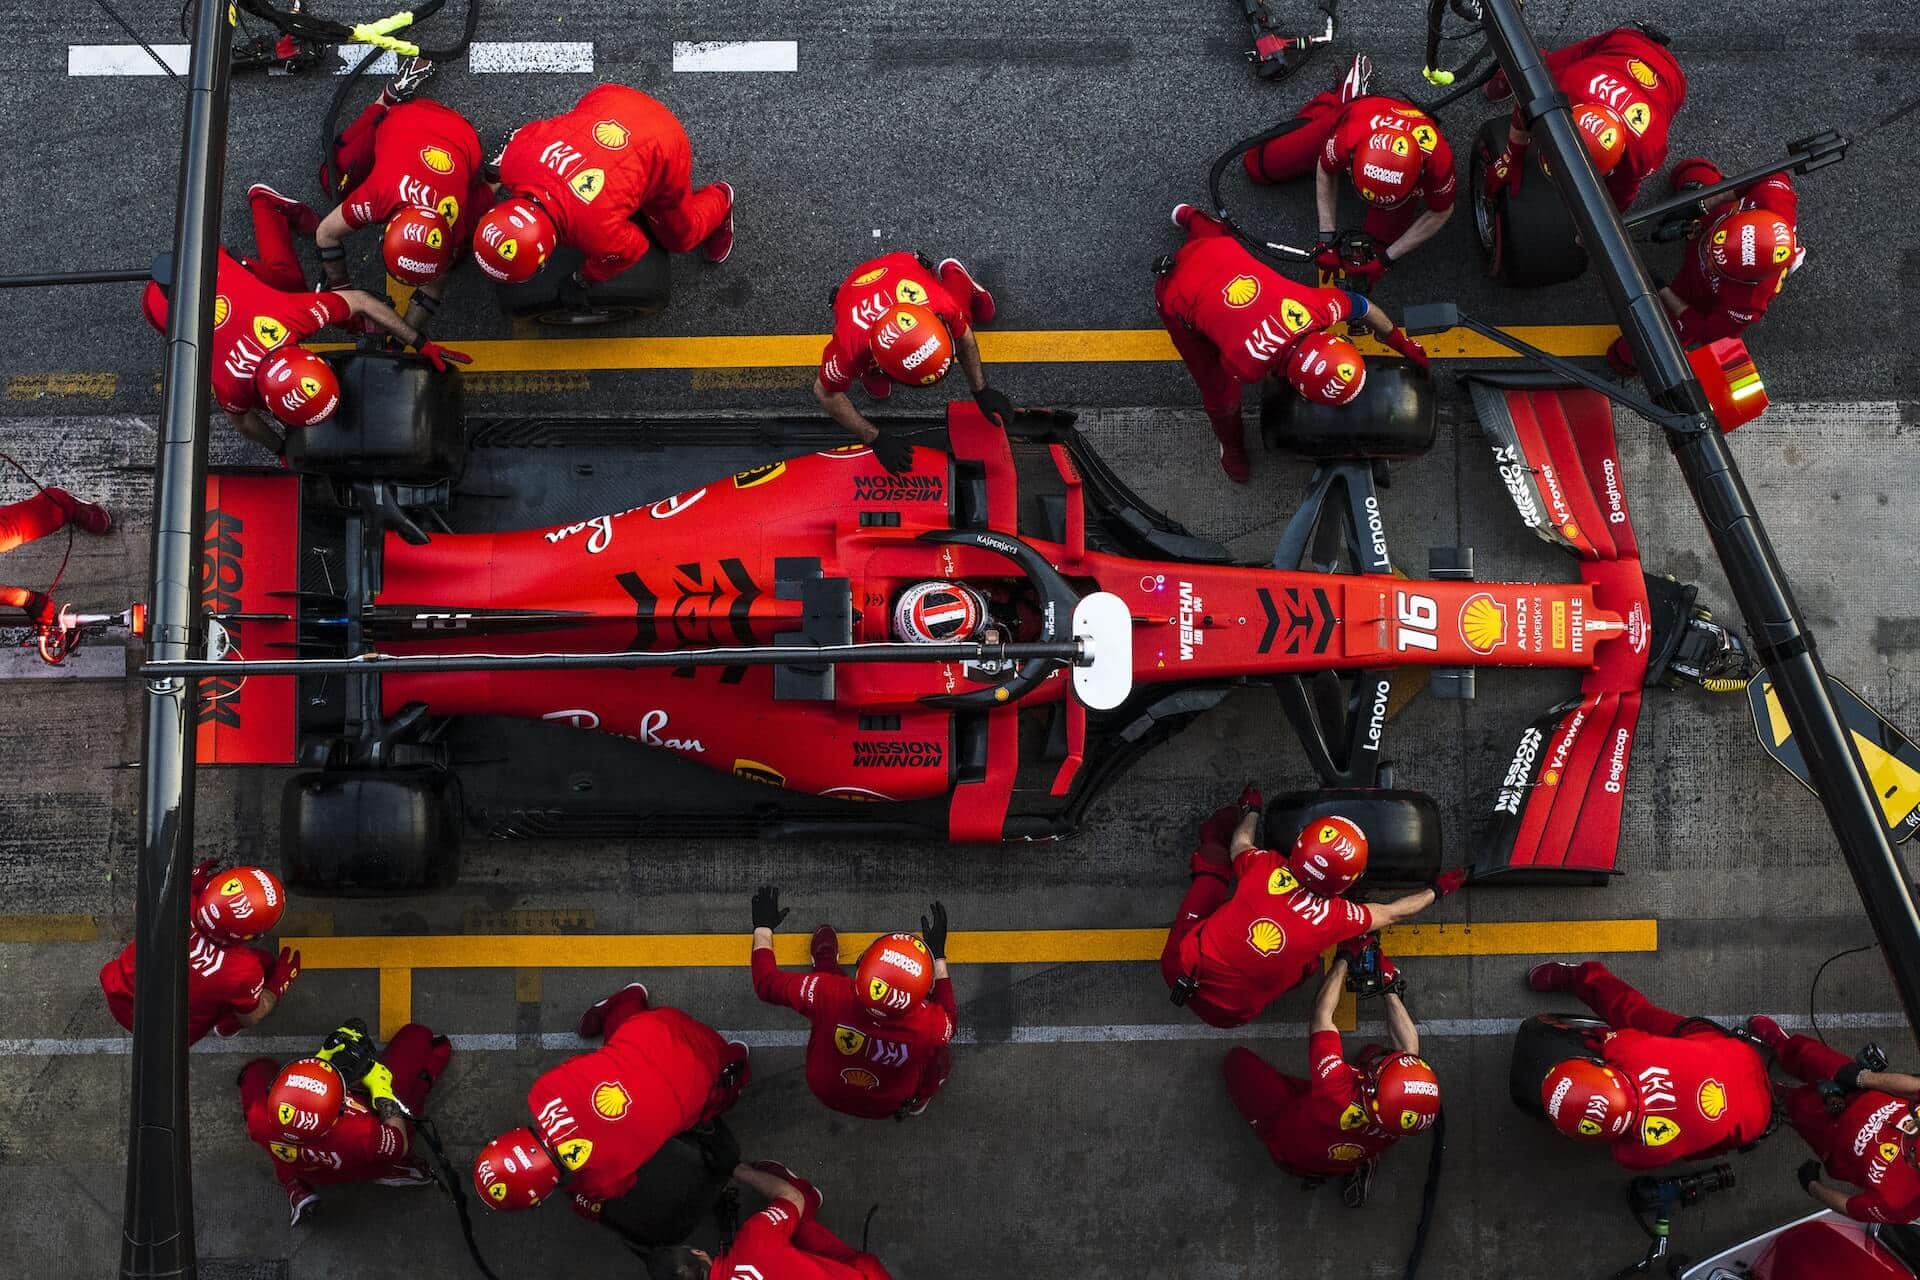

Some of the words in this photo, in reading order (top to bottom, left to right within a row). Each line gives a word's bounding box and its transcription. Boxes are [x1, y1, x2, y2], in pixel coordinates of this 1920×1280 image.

[853, 475, 943, 488] WINNOW
[853, 488, 943, 501] MISSION
[1364, 496, 1389, 566] Lenovo
[1178, 581, 1193, 661] WEICHAI
[1397, 590, 1438, 652] 16
[1516, 611, 1527, 651] AMD
[1572, 597, 1583, 653] MAHLE
[1363, 680, 1391, 751] Lenovo
[1551, 711, 1585, 768] V-Power
[852, 741, 943, 754] MISSION
[852, 755, 943, 768] WINNOW
[1494, 727, 1536, 812] MISSION
[1611, 728, 1630, 781] eightcap
